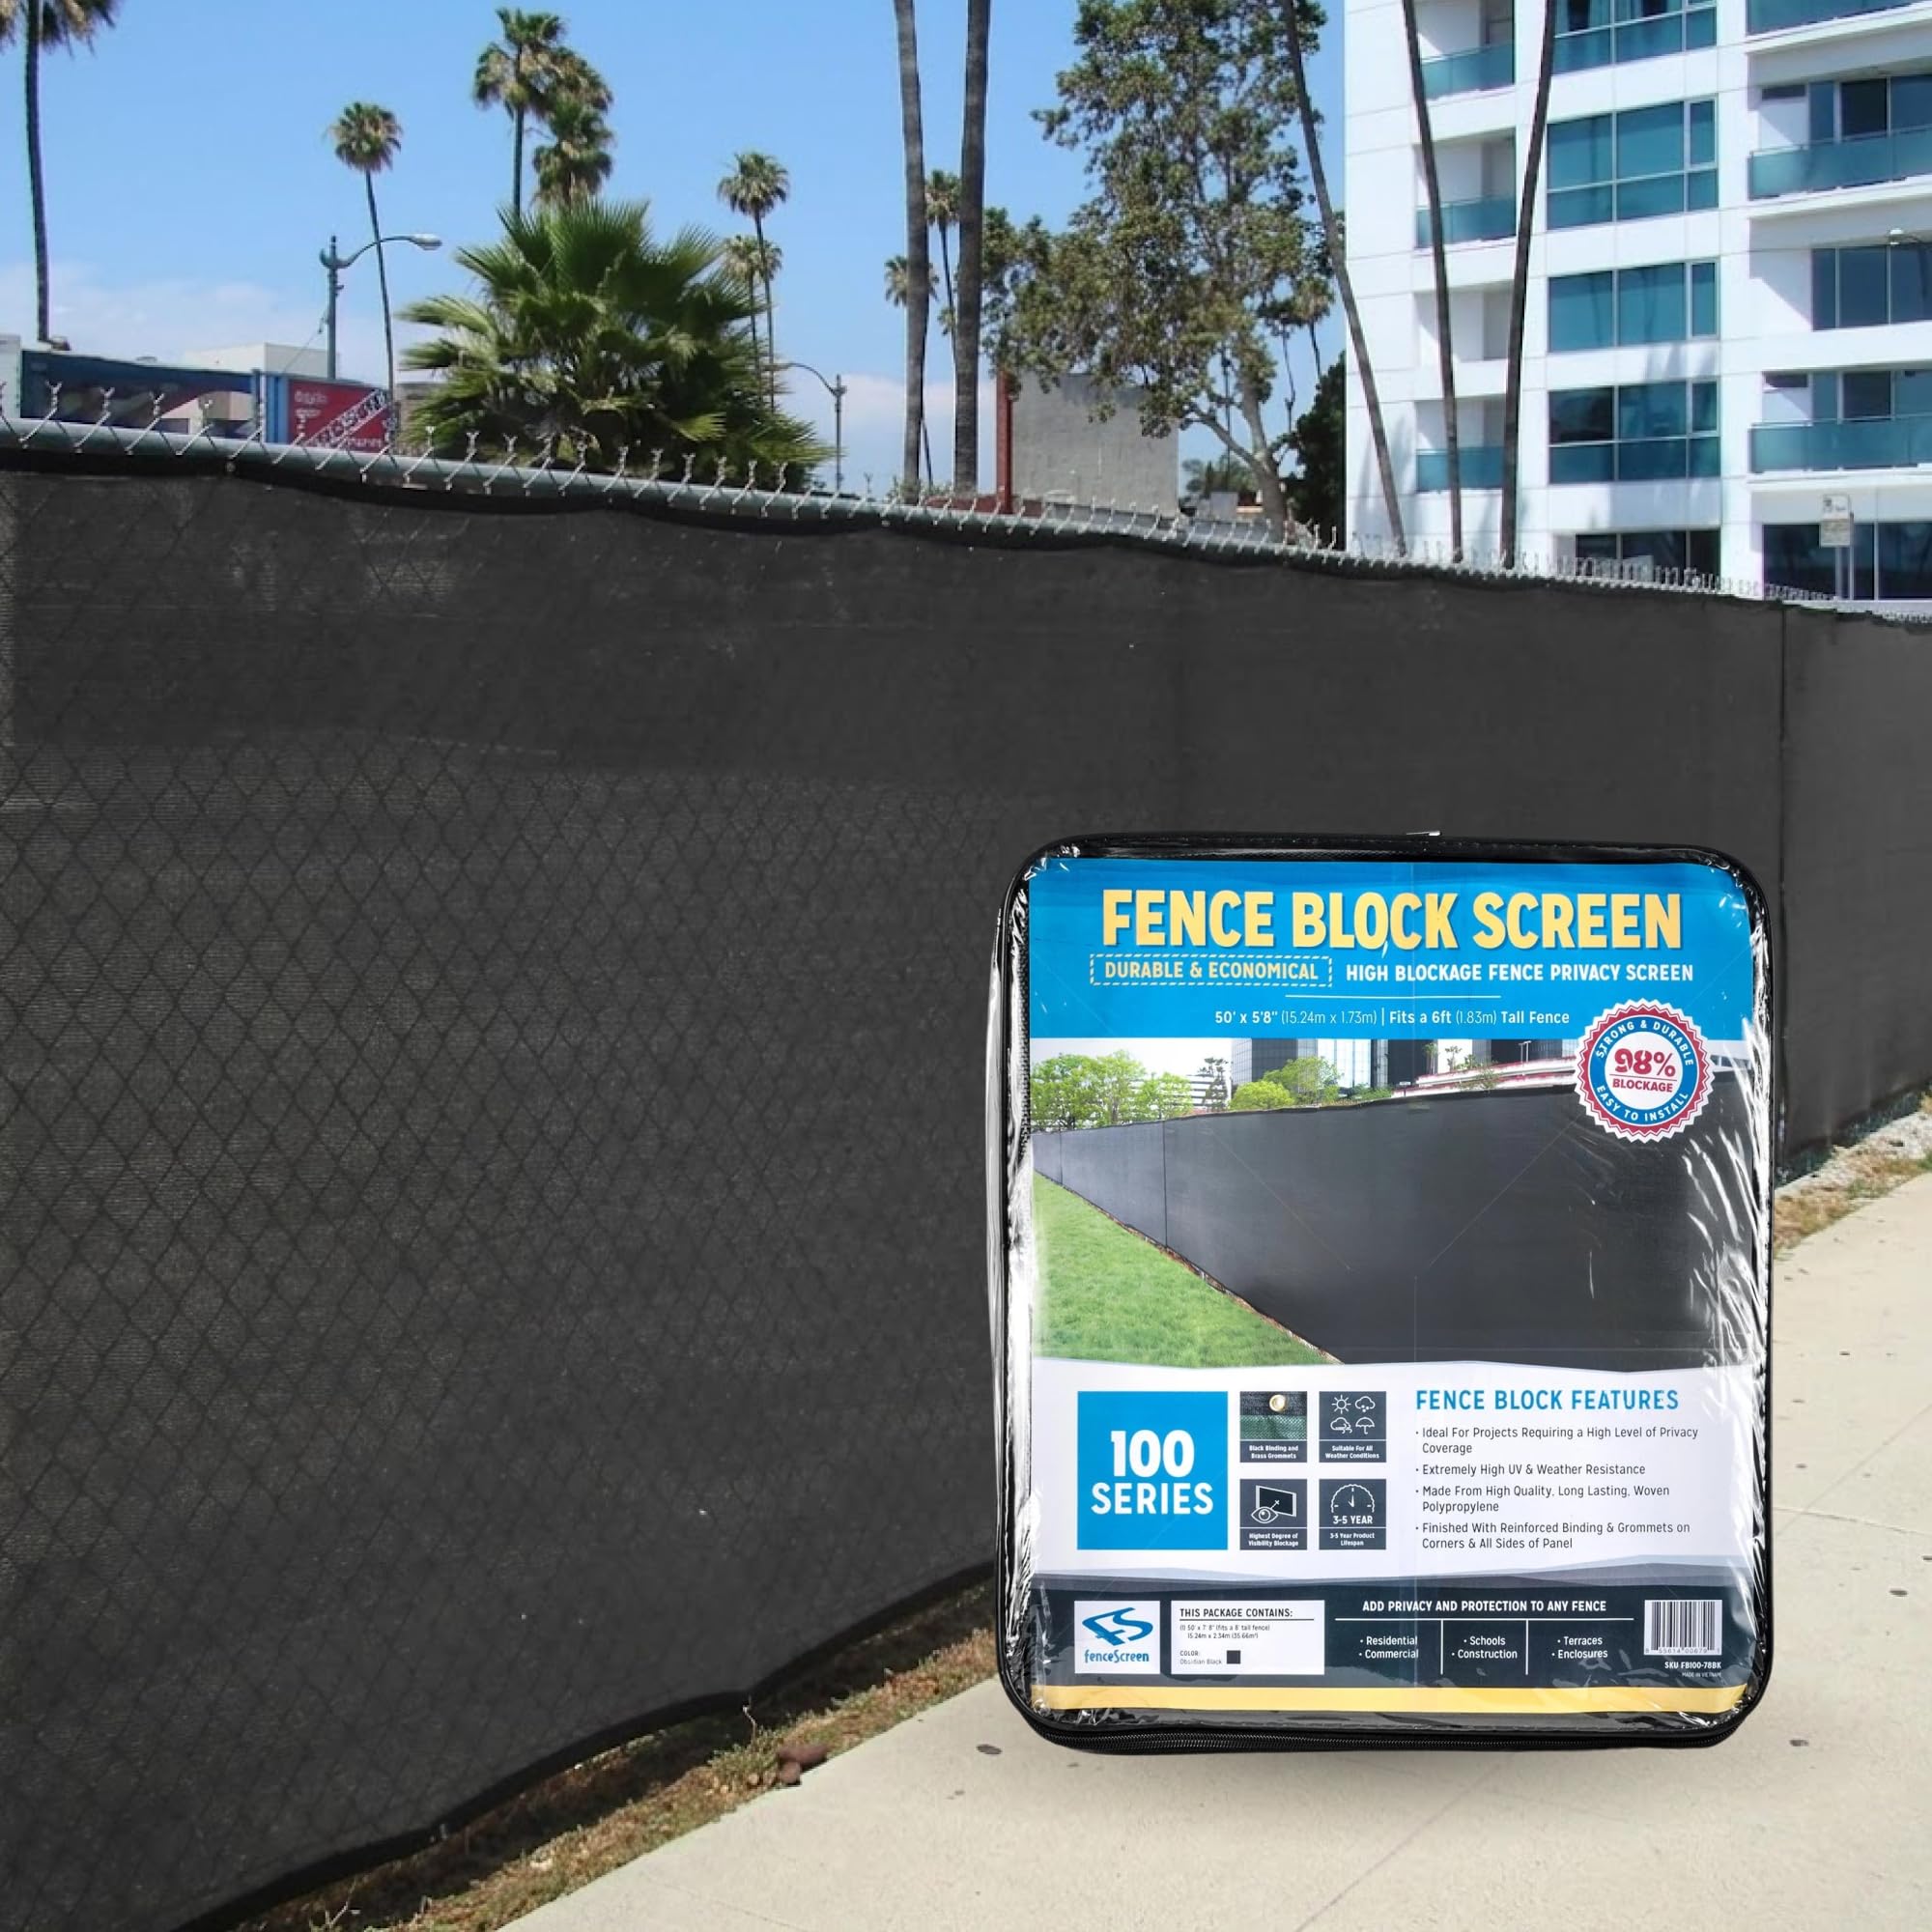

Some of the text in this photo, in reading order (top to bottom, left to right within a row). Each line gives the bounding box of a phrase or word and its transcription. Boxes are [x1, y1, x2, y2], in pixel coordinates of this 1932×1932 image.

[1103, 890, 1681, 950] FENCE BLOCK SCREEN
[1105, 961, 1318, 980] DURABLE & ECONOMICAL
[1347, 964, 1693, 981] HIGH BLOCKAGE FENCE PRIVACY SCREEN
[1215, 1011, 1569, 1025] 50' x 5'8" (15.24m x 1.73m) Fits a 6ft (1.83m) Tall Fence
[1597, 1022, 1634, 1058] STRONG
[1654, 1022, 1693, 1065] DURABLE
[1614, 1048, 1675, 1077] 98%
[1613, 1079, 1673, 1093] BLOCKAGE
[1597, 1086, 1688, 1122] EASY TO INSTALL
[1416, 1390, 1678, 1409] FENCE BLOCK FEATURES
[1423, 1427, 1448, 1437] Ideal
[1452, 1427, 1469, 1437] For
[1474, 1427, 1518, 1439] Projects
[1522, 1427, 1573, 1439] Requiring
[1587, 1427, 1610, 1439] High
[1615, 1427, 1642, 1437] Level
[1646, 1427, 1657, 1437] of
[1661, 1427, 1698, 1439] Privacy
[1111, 1430, 1194, 1477] 100
[1423, 1443, 1472, 1455] Coverage
[1423, 1464, 1645, 1477] Extremely High UV & Weather Resistance
[1091, 1482, 1213, 1515] SERIES
[1423, 1486, 1451, 1496] Made
[1455, 1486, 1482, 1496] From
[1486, 1486, 1510, 1498] High
[1558, 1486, 1583, 1498] Long
[1634, 1486, 1669, 1496] Woven
[1423, 1501, 1499, 1514] Polypropylene
[1333, 1516, 1373, 1524] 3-5 YEAR
[1423, 1522, 1467, 1533] Finished
[1472, 1522, 1496, 1533] With
[1500, 1522, 1558, 1533] Reinforced
[1563, 1522, 1603, 1535] Binding
[1606, 1522, 1614, 1533] &
[1618, 1522, 1673, 1533] Grommets
[1422, 1538, 1572, 1548] Corners & All Sides of Panel
[1179, 1608, 1293, 1617] THIS PACKAGE CONTAINS:
[1362, 1601, 1606, 1611] ADD PRIVACY AND PROTECTION TO ANY FENCE
[1367, 1636, 1417, 1645] Residential
[1470, 1636, 1505, 1645] Schools
[1564, 1636, 1603, 1645] Terraces
[1085, 1649, 1149, 1663] fenceScreen
[1365, 1650, 1418, 1659] Commercial
[1458, 1650, 1518, 1659] Construction
[1558, 1649, 1607, 1659] Enclosures
